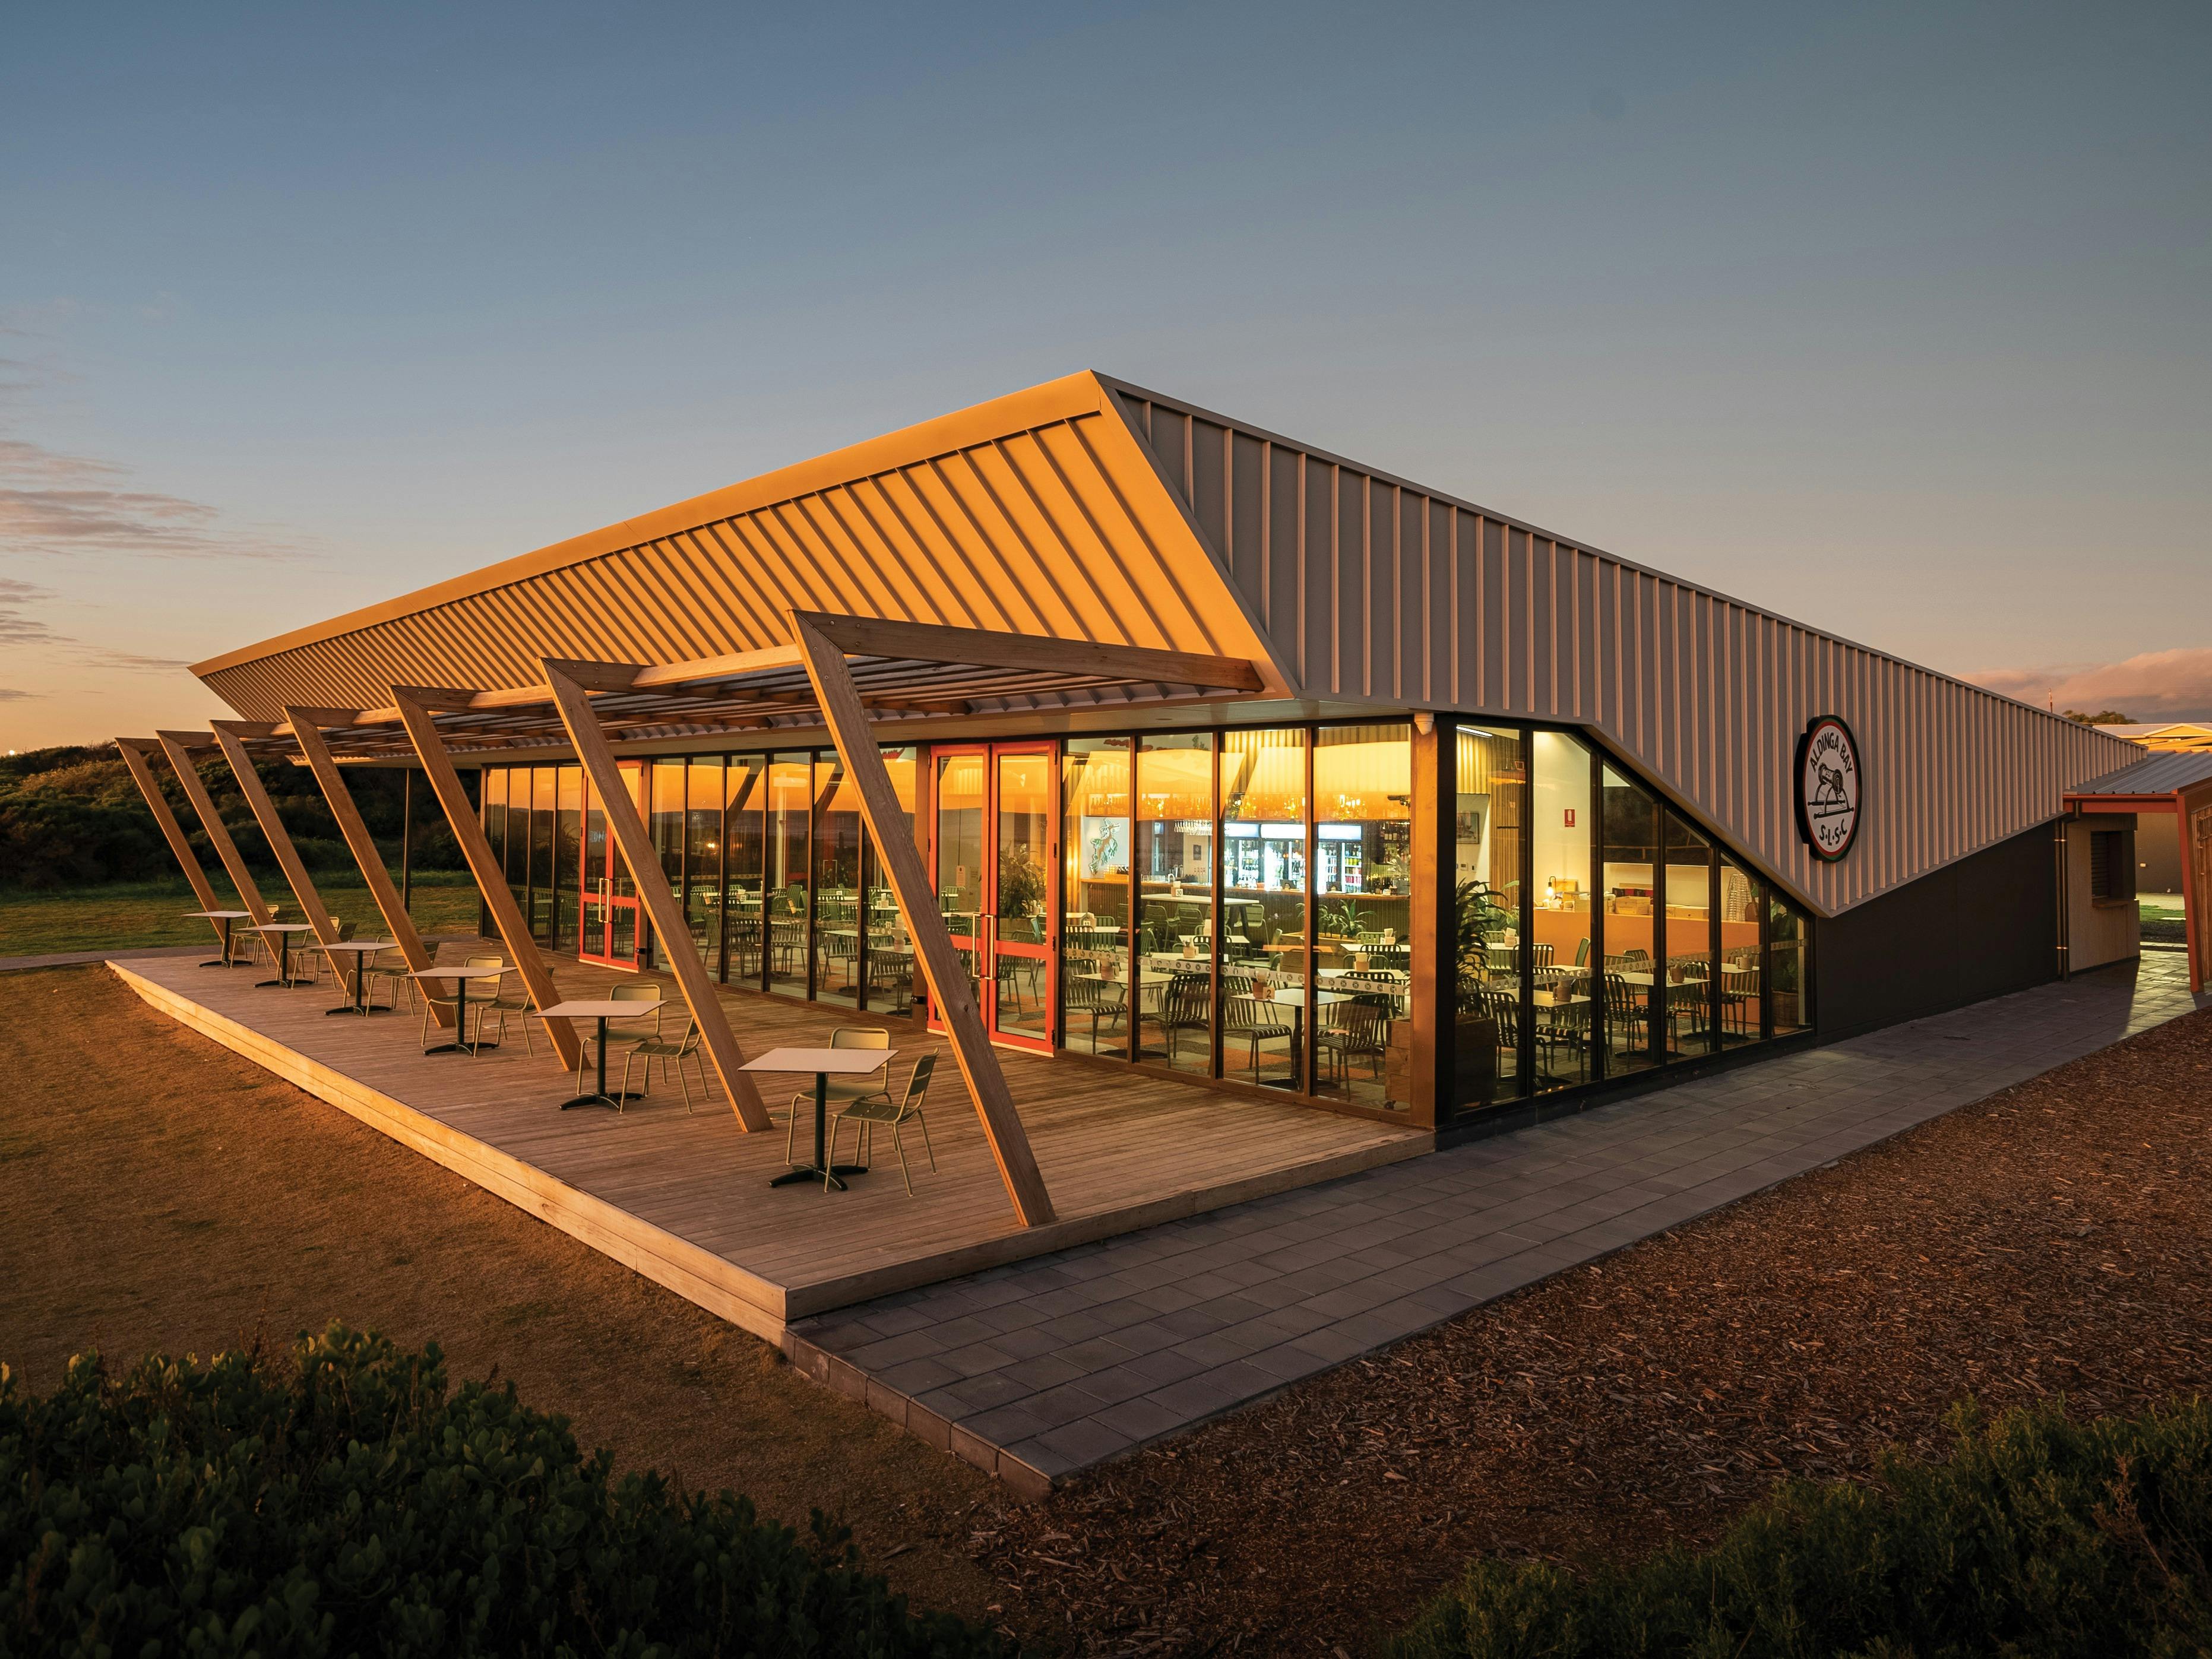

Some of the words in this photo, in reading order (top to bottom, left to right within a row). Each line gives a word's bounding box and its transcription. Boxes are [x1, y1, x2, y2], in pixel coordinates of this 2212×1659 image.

[1810, 732, 1839, 773] ALDINGA
[1840, 743, 1853, 774] BAY
[1267, 989, 1271, 999] 2
